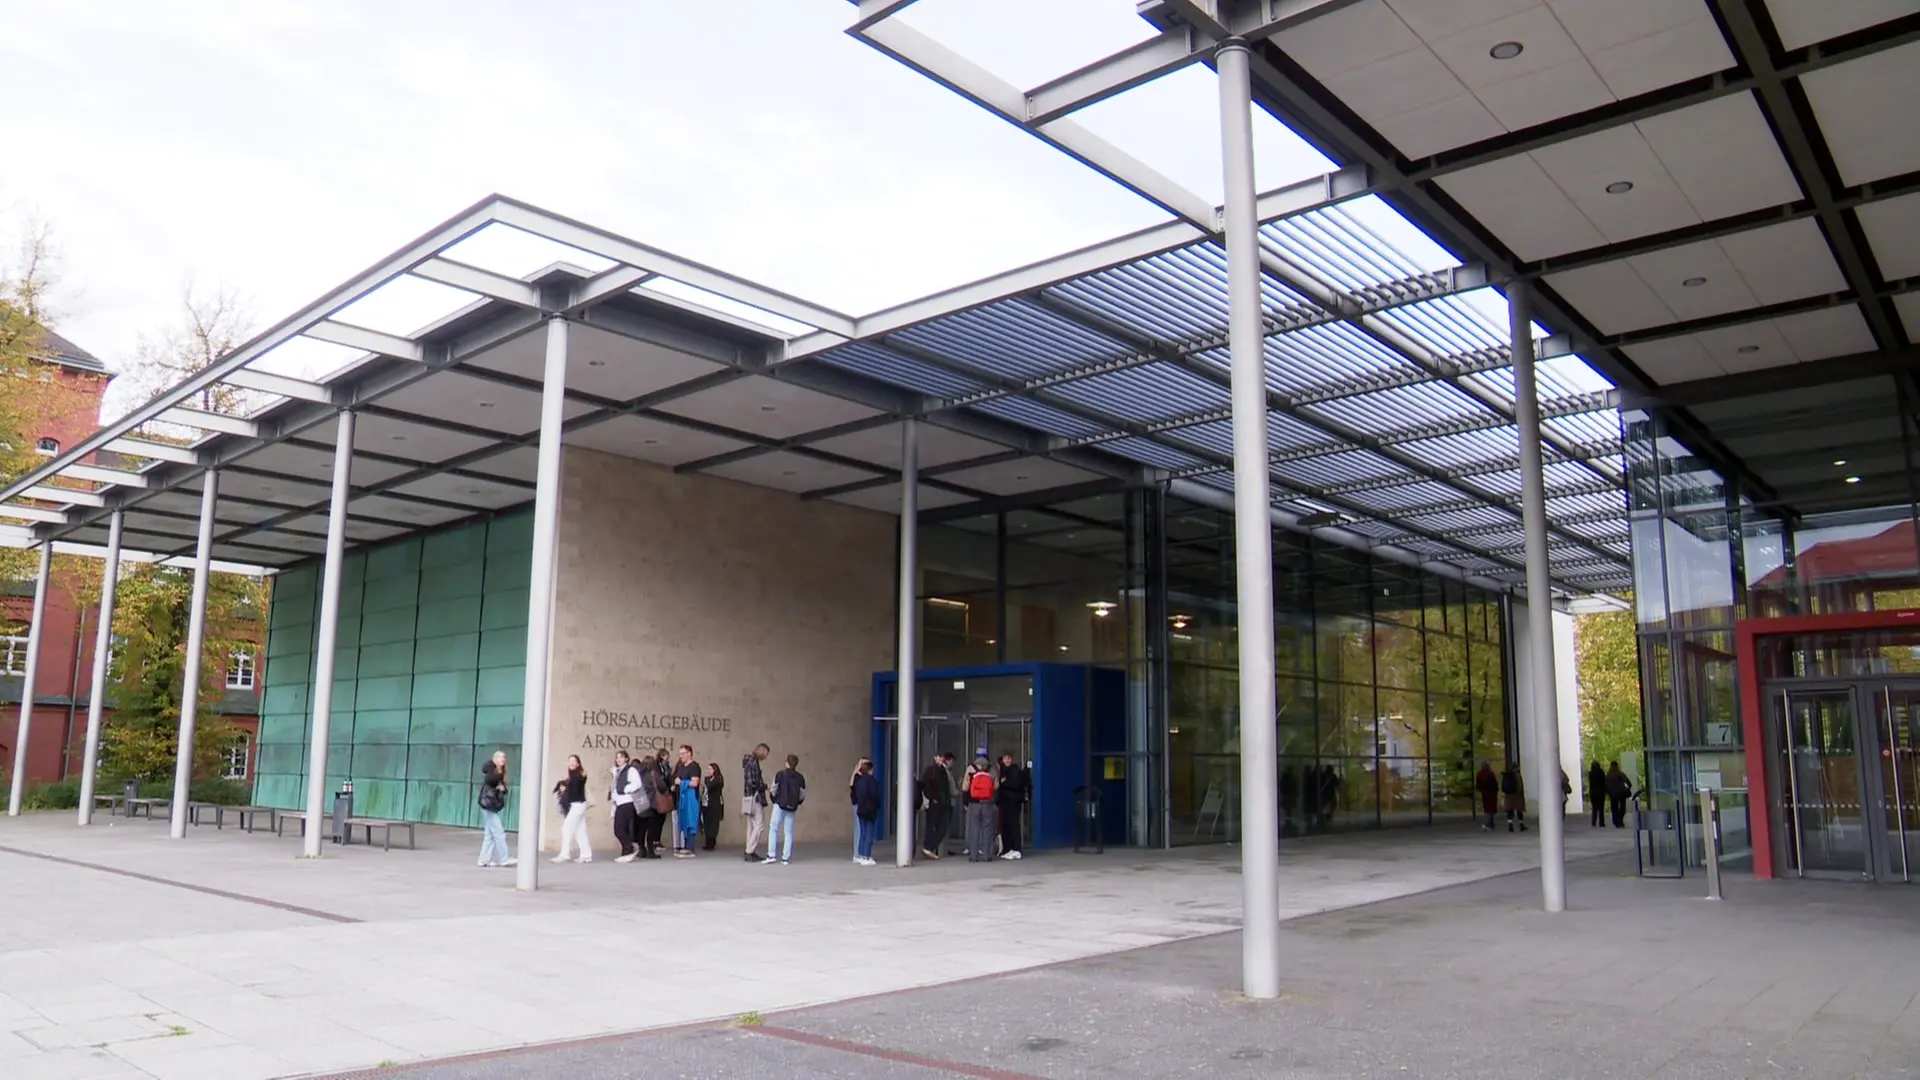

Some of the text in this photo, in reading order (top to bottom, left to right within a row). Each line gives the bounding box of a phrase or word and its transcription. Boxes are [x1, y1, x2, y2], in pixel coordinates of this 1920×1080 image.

[582, 709, 731, 732] HÖRSAALGEBÄUDE
[1718, 724, 1730, 742] 7
[582, 734, 674, 751] ARNO ESCH
